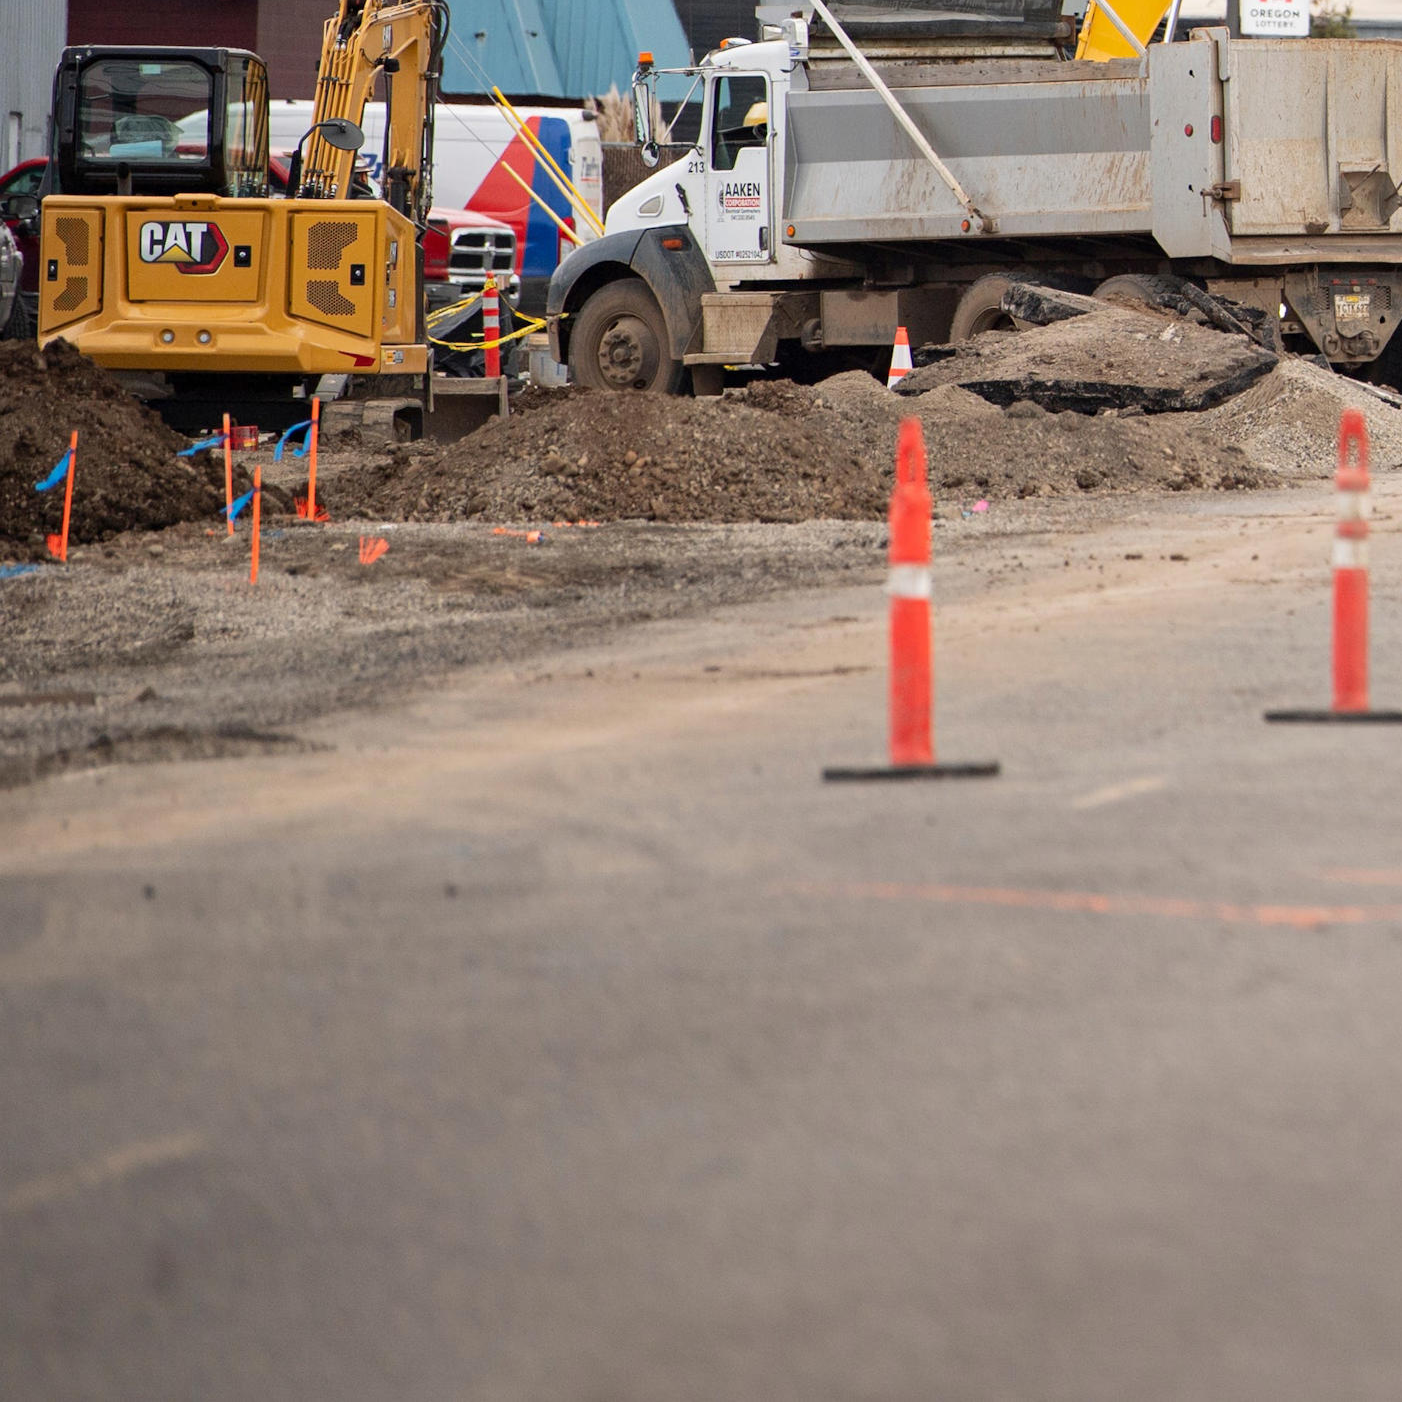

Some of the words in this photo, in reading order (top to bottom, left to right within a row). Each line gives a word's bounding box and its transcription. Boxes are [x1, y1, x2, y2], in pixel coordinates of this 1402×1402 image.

[1250, 8, 1300, 18] OREGON
[688, 161, 705, 173] 213
[725, 182, 760, 197] AAKEN
[141, 222, 208, 263] CAT
